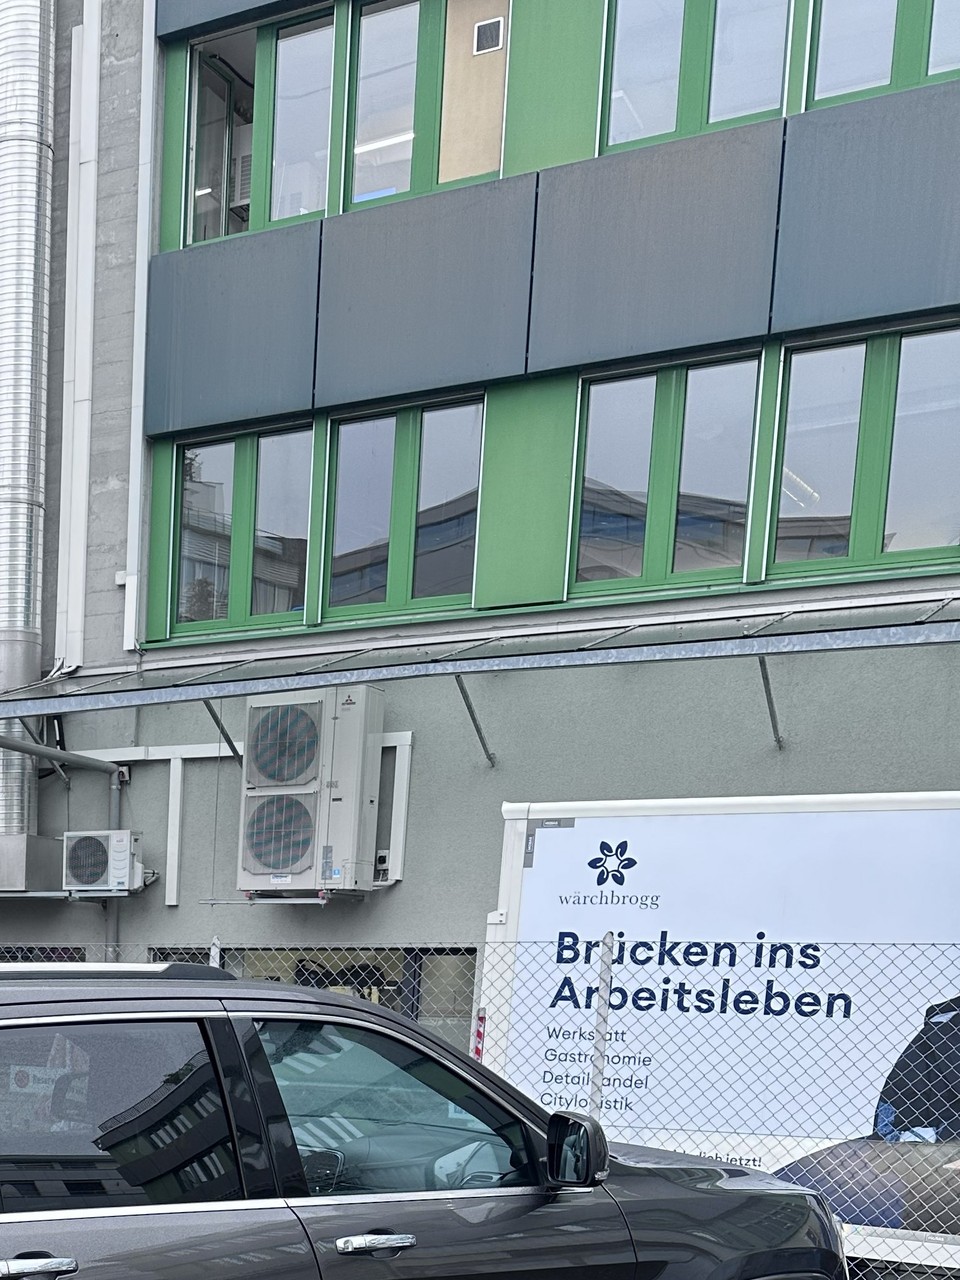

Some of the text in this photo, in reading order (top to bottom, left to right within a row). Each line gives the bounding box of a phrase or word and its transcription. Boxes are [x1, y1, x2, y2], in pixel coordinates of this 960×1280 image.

[558, 890, 661, 910] wärchbrogg
[754, 931, 821, 969] ins
[549, 976, 853, 1019] Arbeitsleben
[546, 1026, 627, 1042] Werksatt
[542, 1070, 649, 1089] Detailandel
[540, 1092, 633, 1111] Cityloistik
